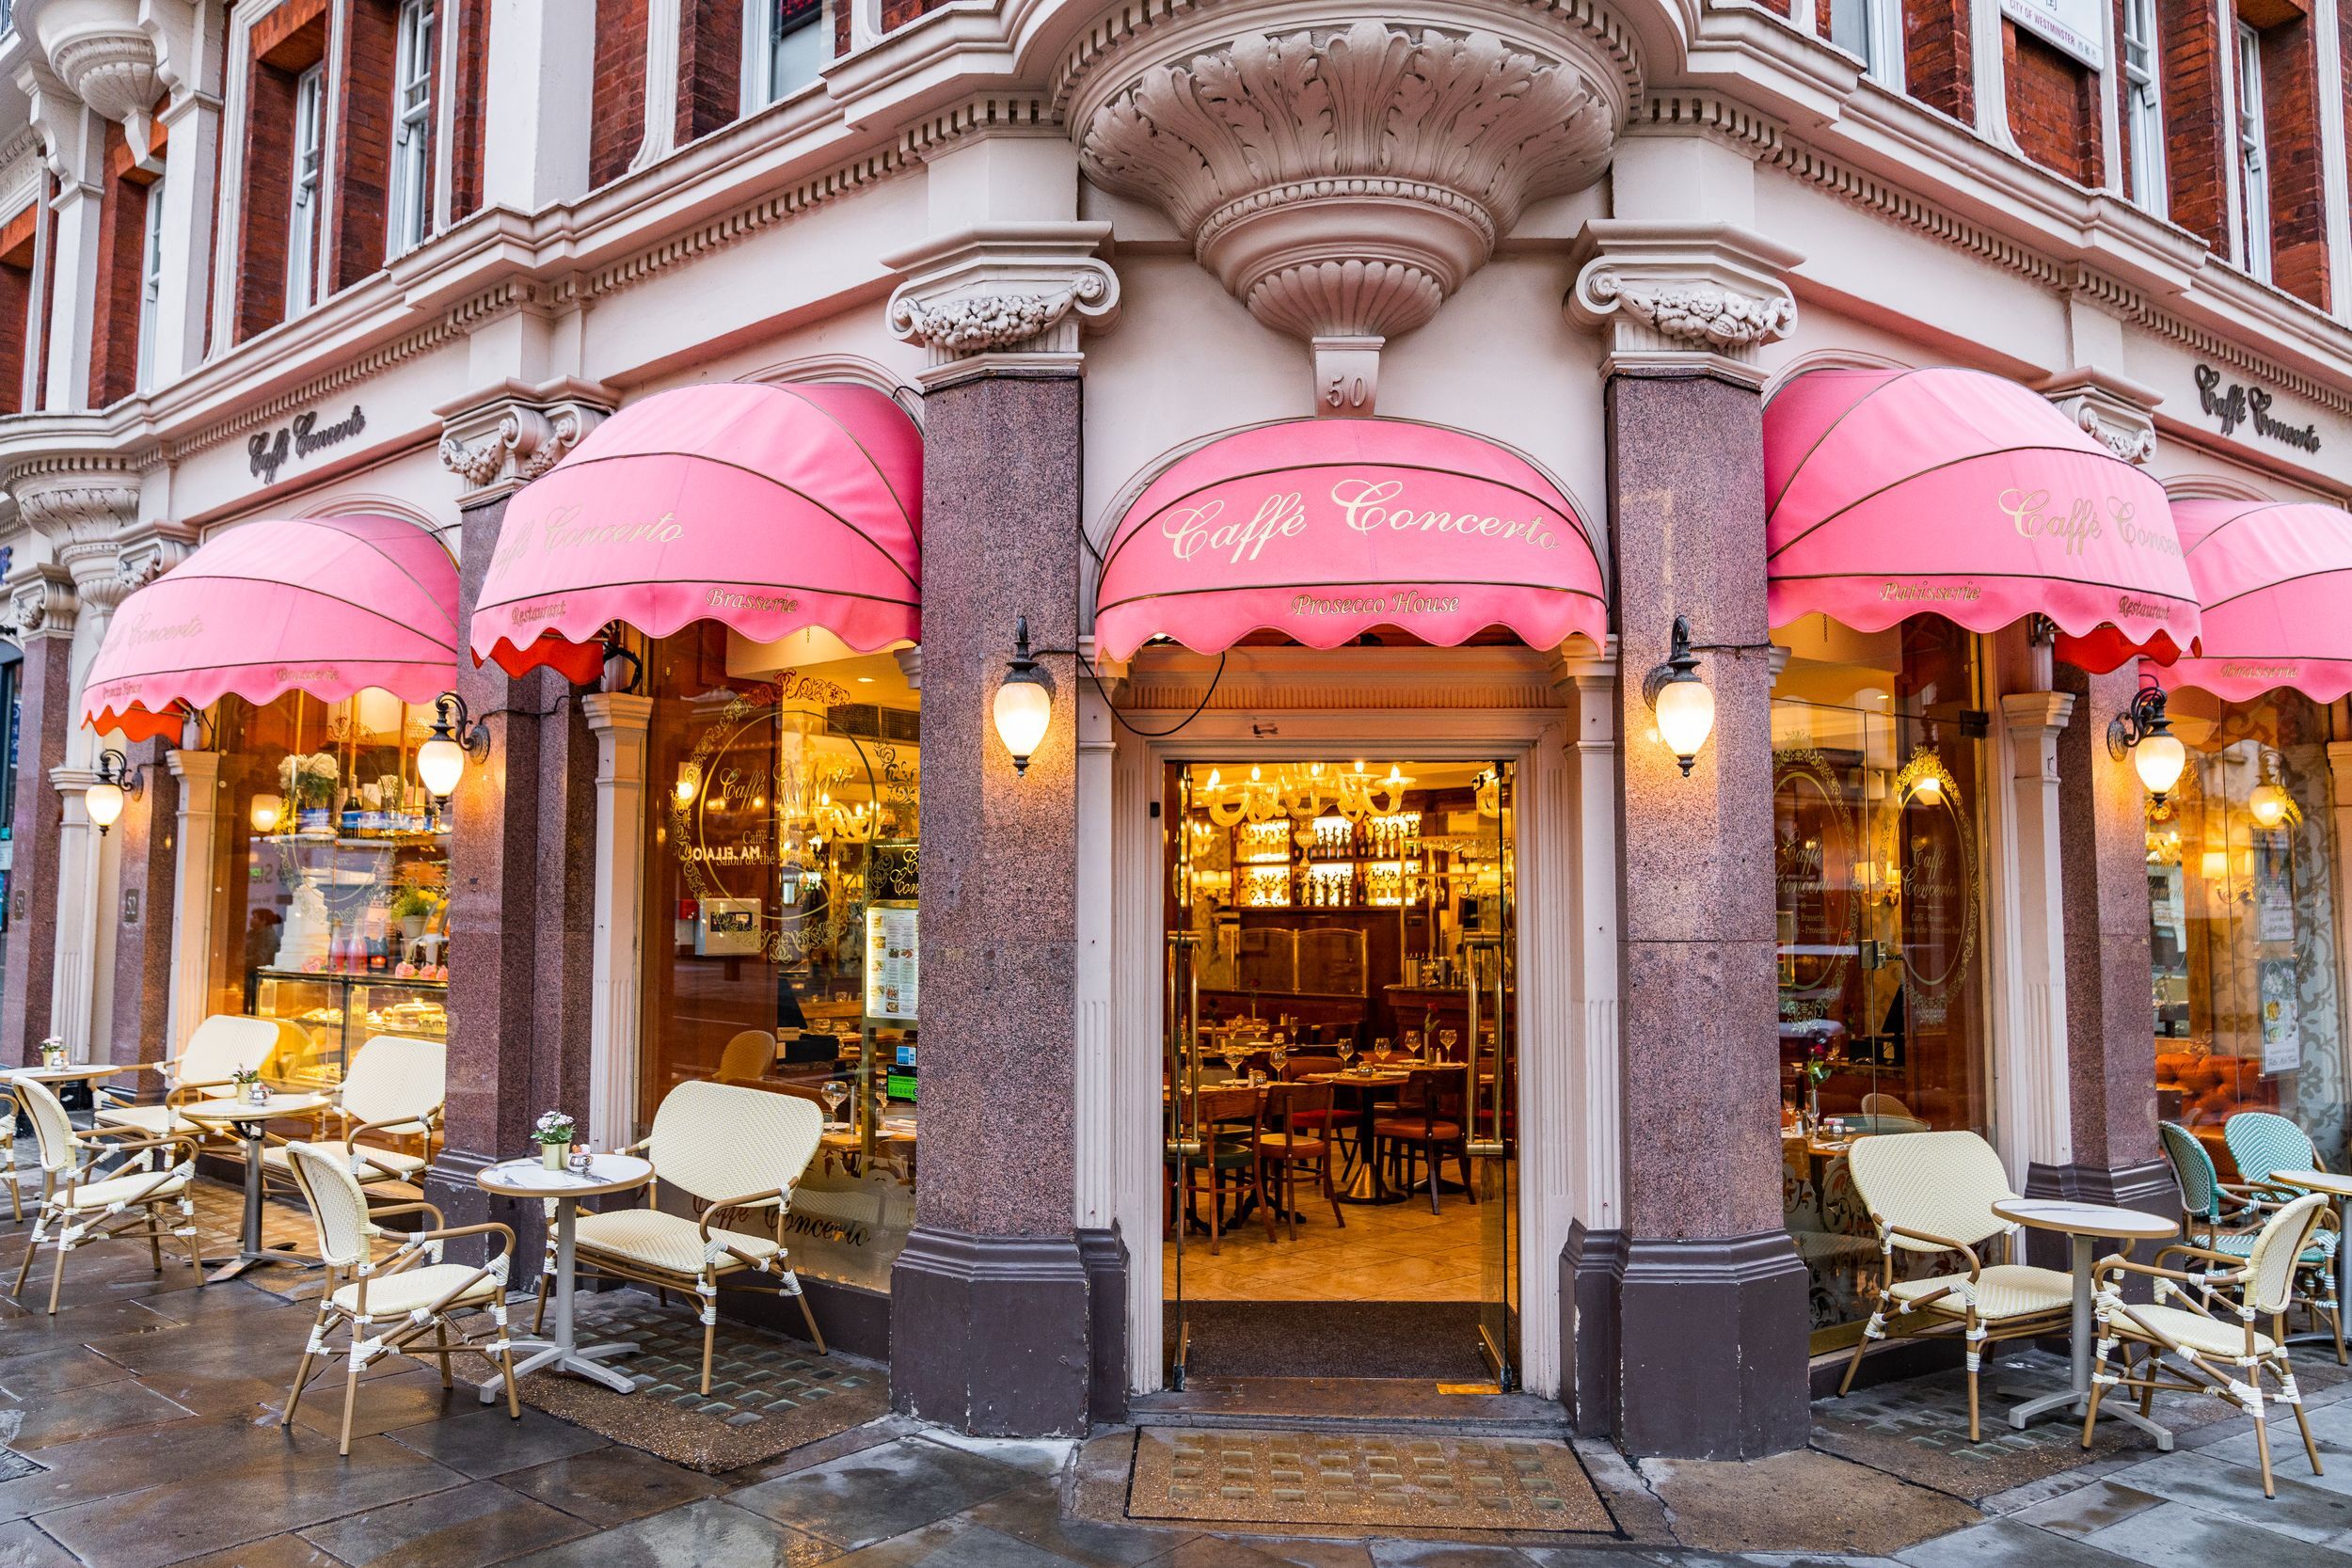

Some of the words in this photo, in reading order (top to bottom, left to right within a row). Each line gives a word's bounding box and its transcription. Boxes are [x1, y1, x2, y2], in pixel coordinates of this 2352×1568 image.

[2010, 0, 2024, 14] CITY
[2025, 7, 2033, 20] OF
[2034, 13, 2075, 46] WESTMINSTER
[1325, 374, 1369, 408] 50
[293, 404, 366, 459] Concerto
[2248, 387, 2321, 454] Concerto
[543, 503, 686, 555] Concerto
[1162, 491, 1308, 564] Caffé
[1330, 478, 1561, 551] Concerto
[706, 587, 799, 614] Brasserie
[1291, 594, 1386, 616] Prosecco
[1391, 590, 1459, 613] House
[1879, 579, 1981, 602] Patisserie
[511, 600, 567, 626] Restaurant
[2119, 594, 2170, 621] Restaurant
[2221, 662, 2299, 678] Brasserie
